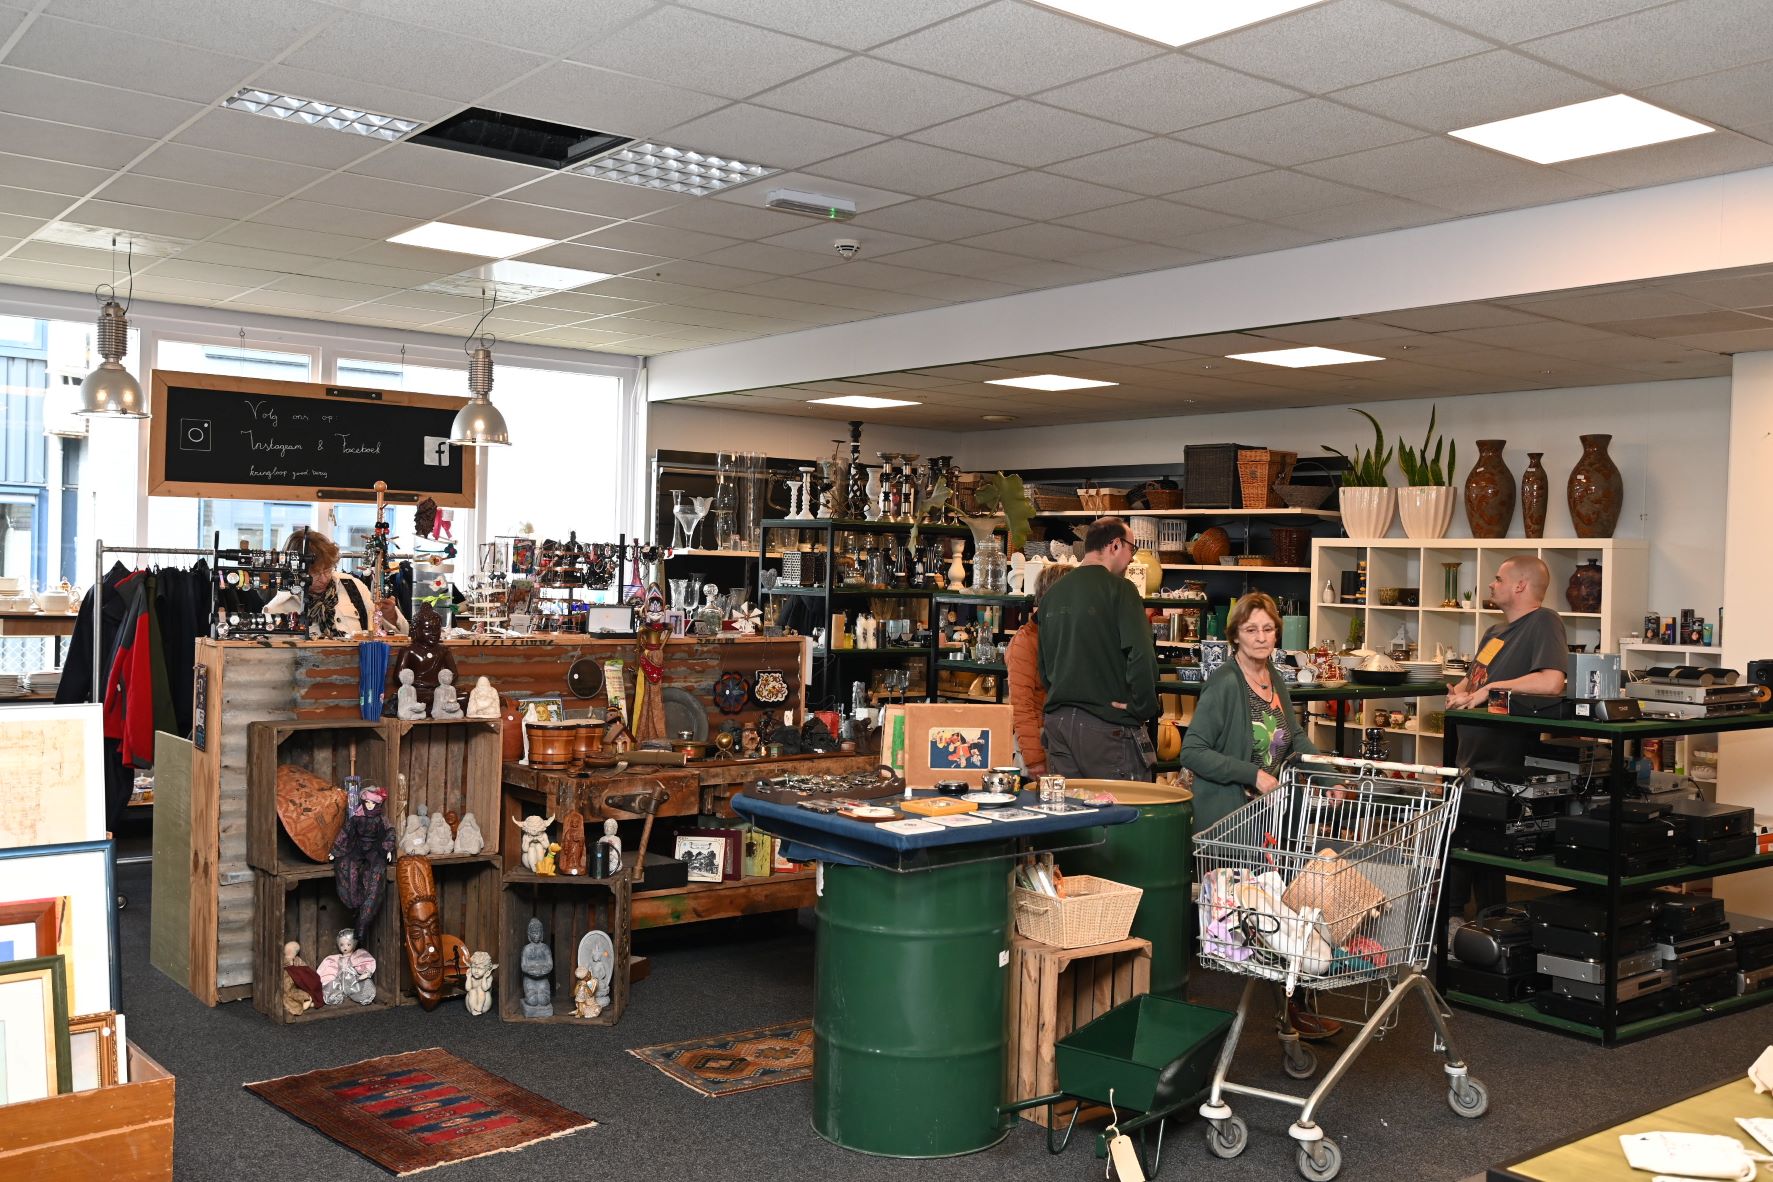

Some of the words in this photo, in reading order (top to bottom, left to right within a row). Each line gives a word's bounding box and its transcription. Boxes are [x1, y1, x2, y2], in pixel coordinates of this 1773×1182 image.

[244, 400, 278, 427] Volg
[240, 430, 303, 457] Instagram
[317, 439, 324, 451] &
